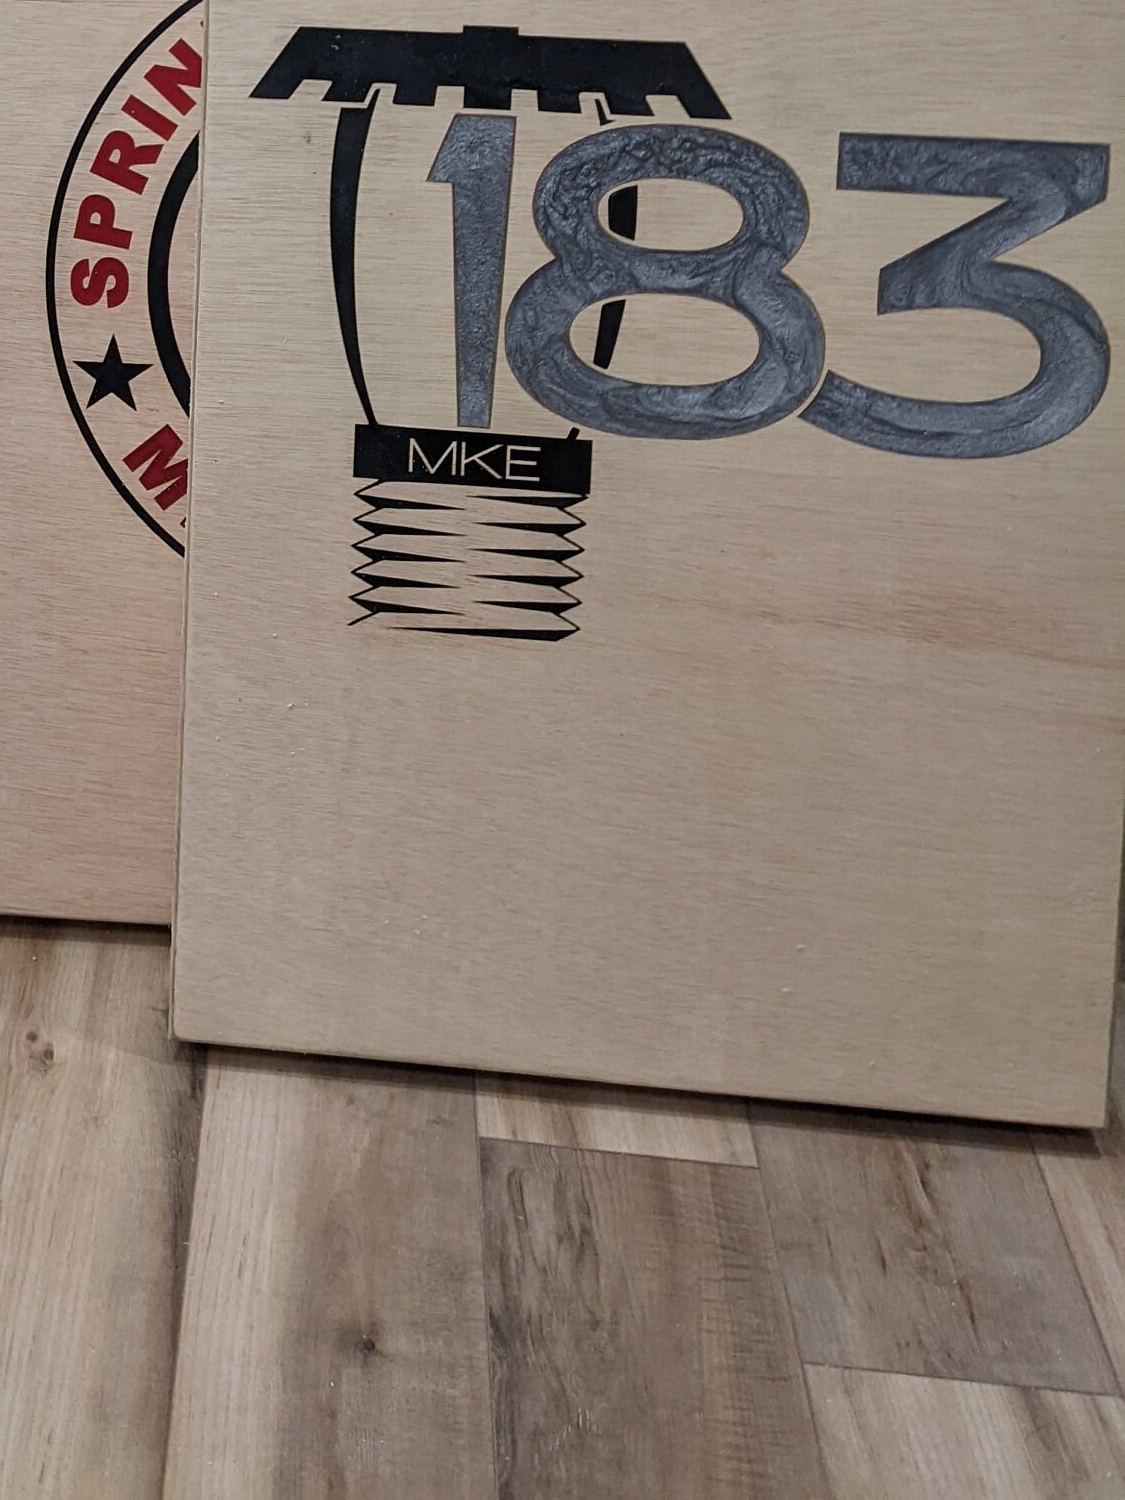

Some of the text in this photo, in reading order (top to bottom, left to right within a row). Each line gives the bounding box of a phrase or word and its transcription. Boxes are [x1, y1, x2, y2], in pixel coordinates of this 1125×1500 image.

[70, 20, 204, 309] SPRIN
[427, 112, 1110, 458] 183
[122, 423, 188, 528] M
[408, 437, 542, 482] MKE
